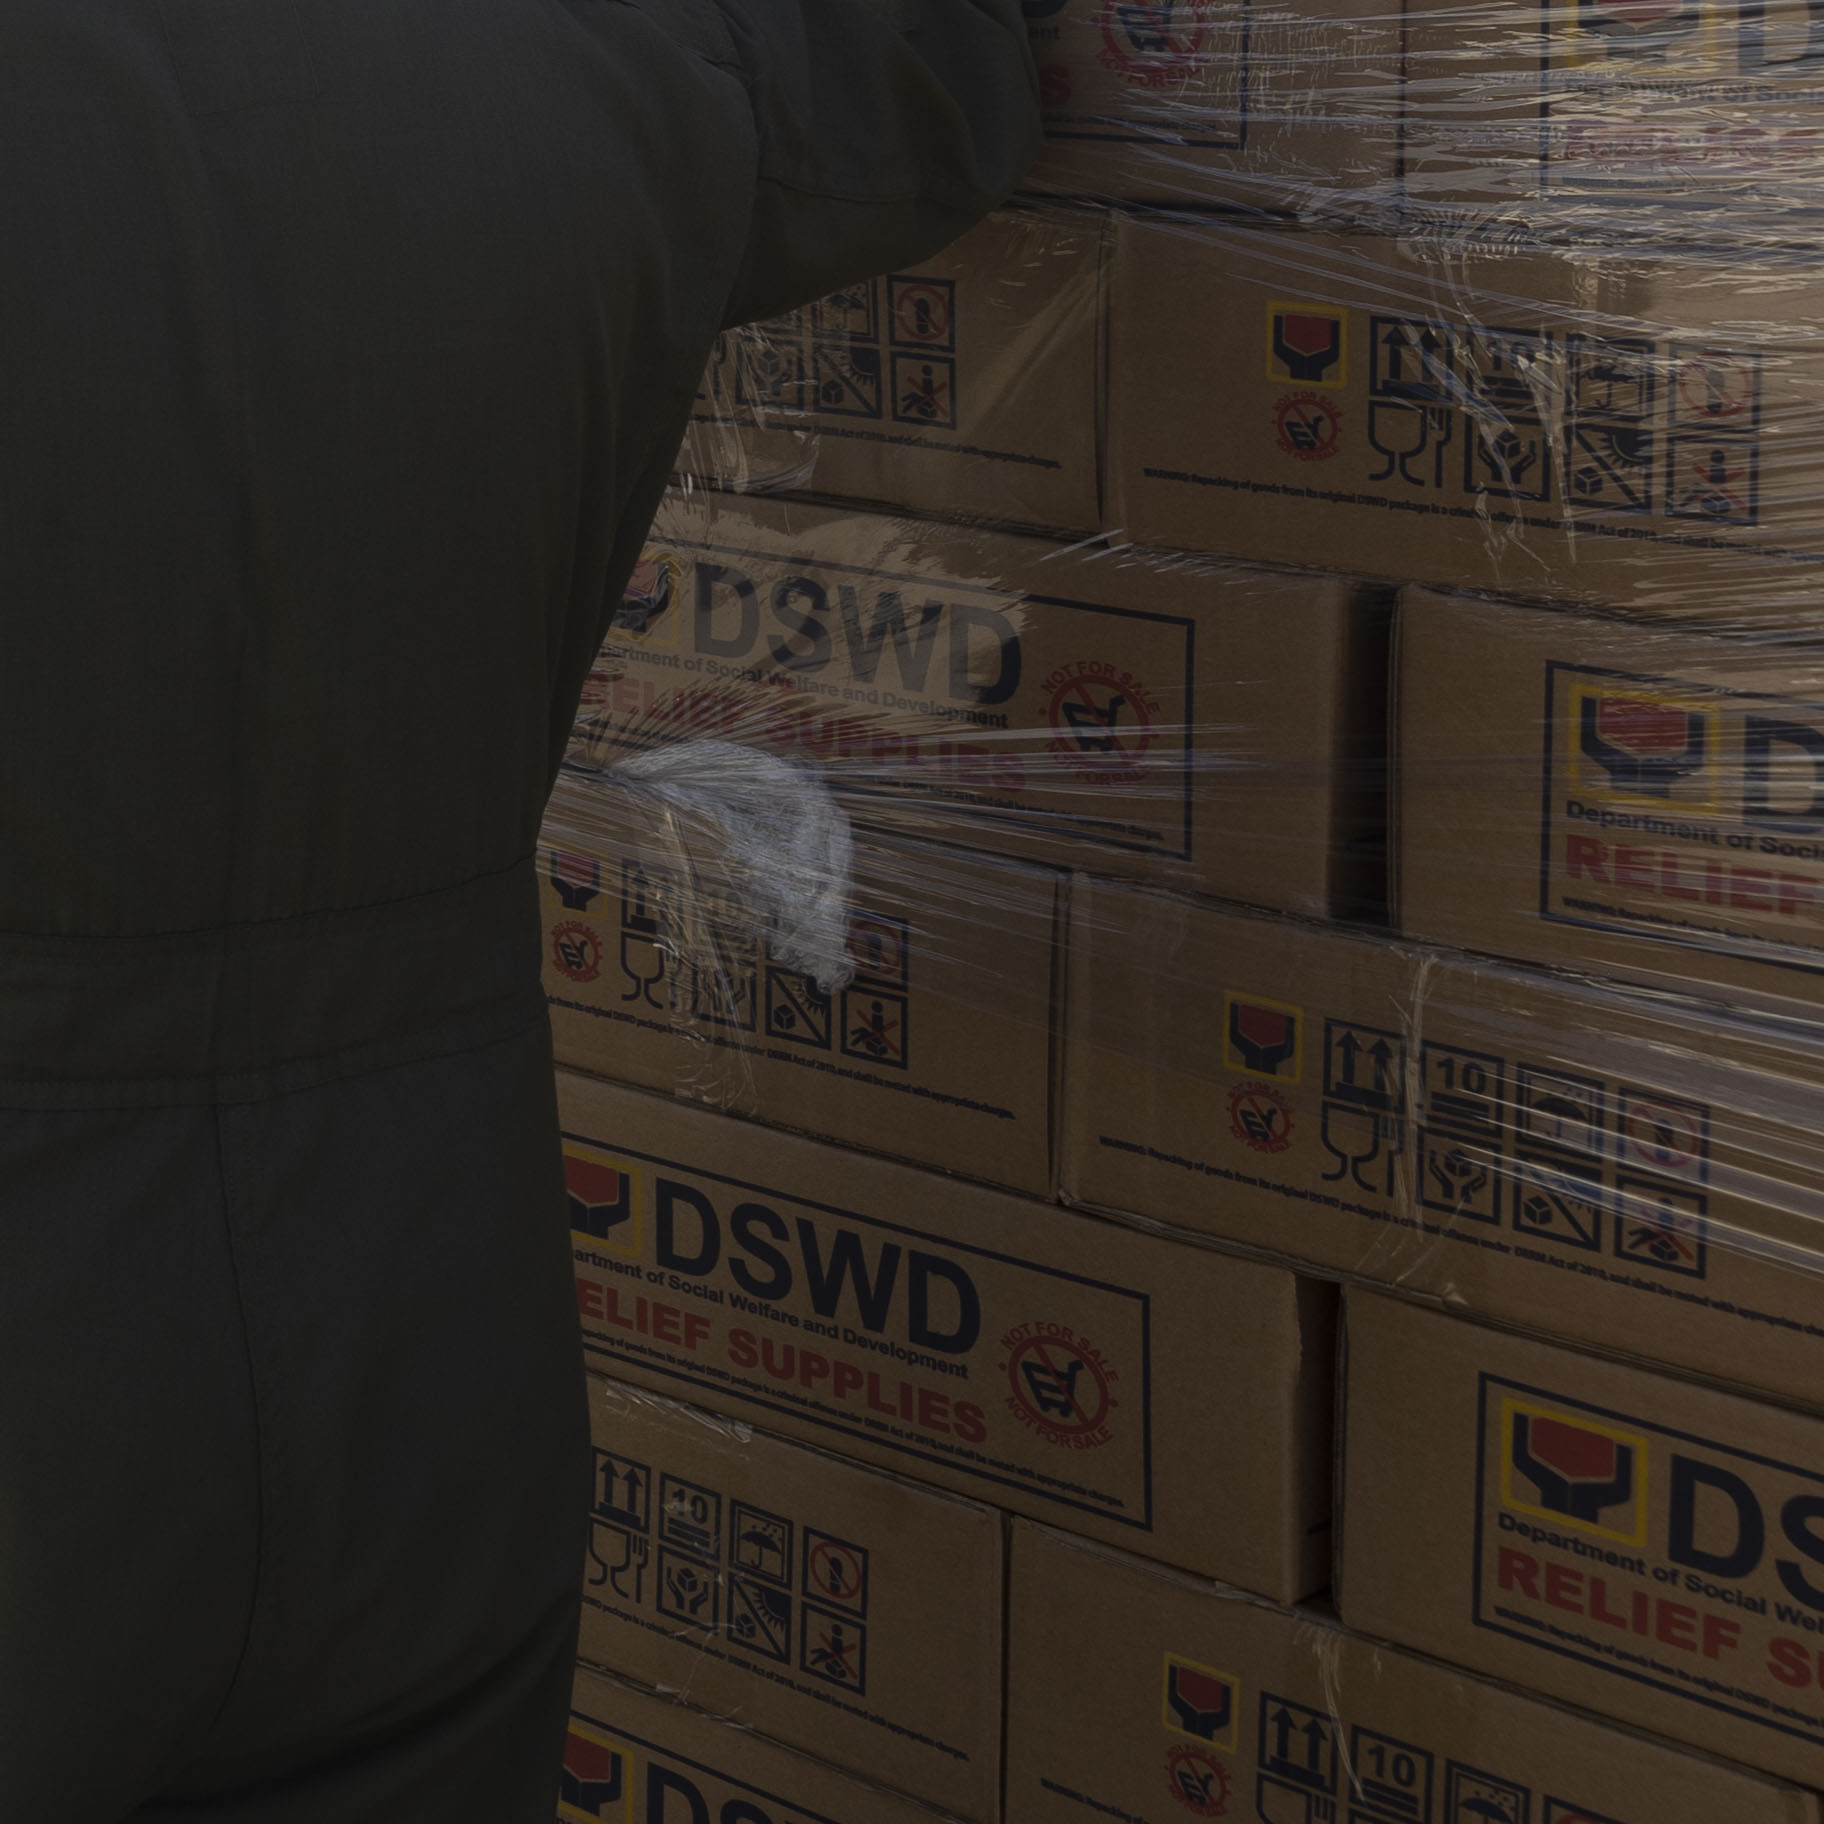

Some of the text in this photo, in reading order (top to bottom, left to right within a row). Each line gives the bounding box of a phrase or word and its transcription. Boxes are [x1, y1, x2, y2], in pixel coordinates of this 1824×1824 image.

[694, 563, 1022, 702] DSWD
[1040, 663, 1073, 694] NOT
[1076, 660, 1117, 678] FOR
[1566, 800, 1719, 847] Department
[1566, 833, 1819, 915] RELIEF
[1436, 1057, 1486, 1095] 10
[656, 1177, 981, 1355] DSWD
[574, 1250, 641, 1282] artment
[668, 1273, 723, 1305] Social
[728, 1292, 798, 1329] Welfare
[842, 1326, 968, 1382] Development
[999, 1320, 1120, 1384] NOT FOR SALE
[578, 1279, 987, 1447] ELIEF SUPPLIES
[1004, 1397, 1038, 1428] NOT
[1497, 1511, 1646, 1576] Department
[1653, 1567, 1680, 1590] of
[1685, 1574, 1766, 1616] Social
[1497, 1544, 1742, 1661] RELIEF
[1367, 1744, 1417, 1787] 10
